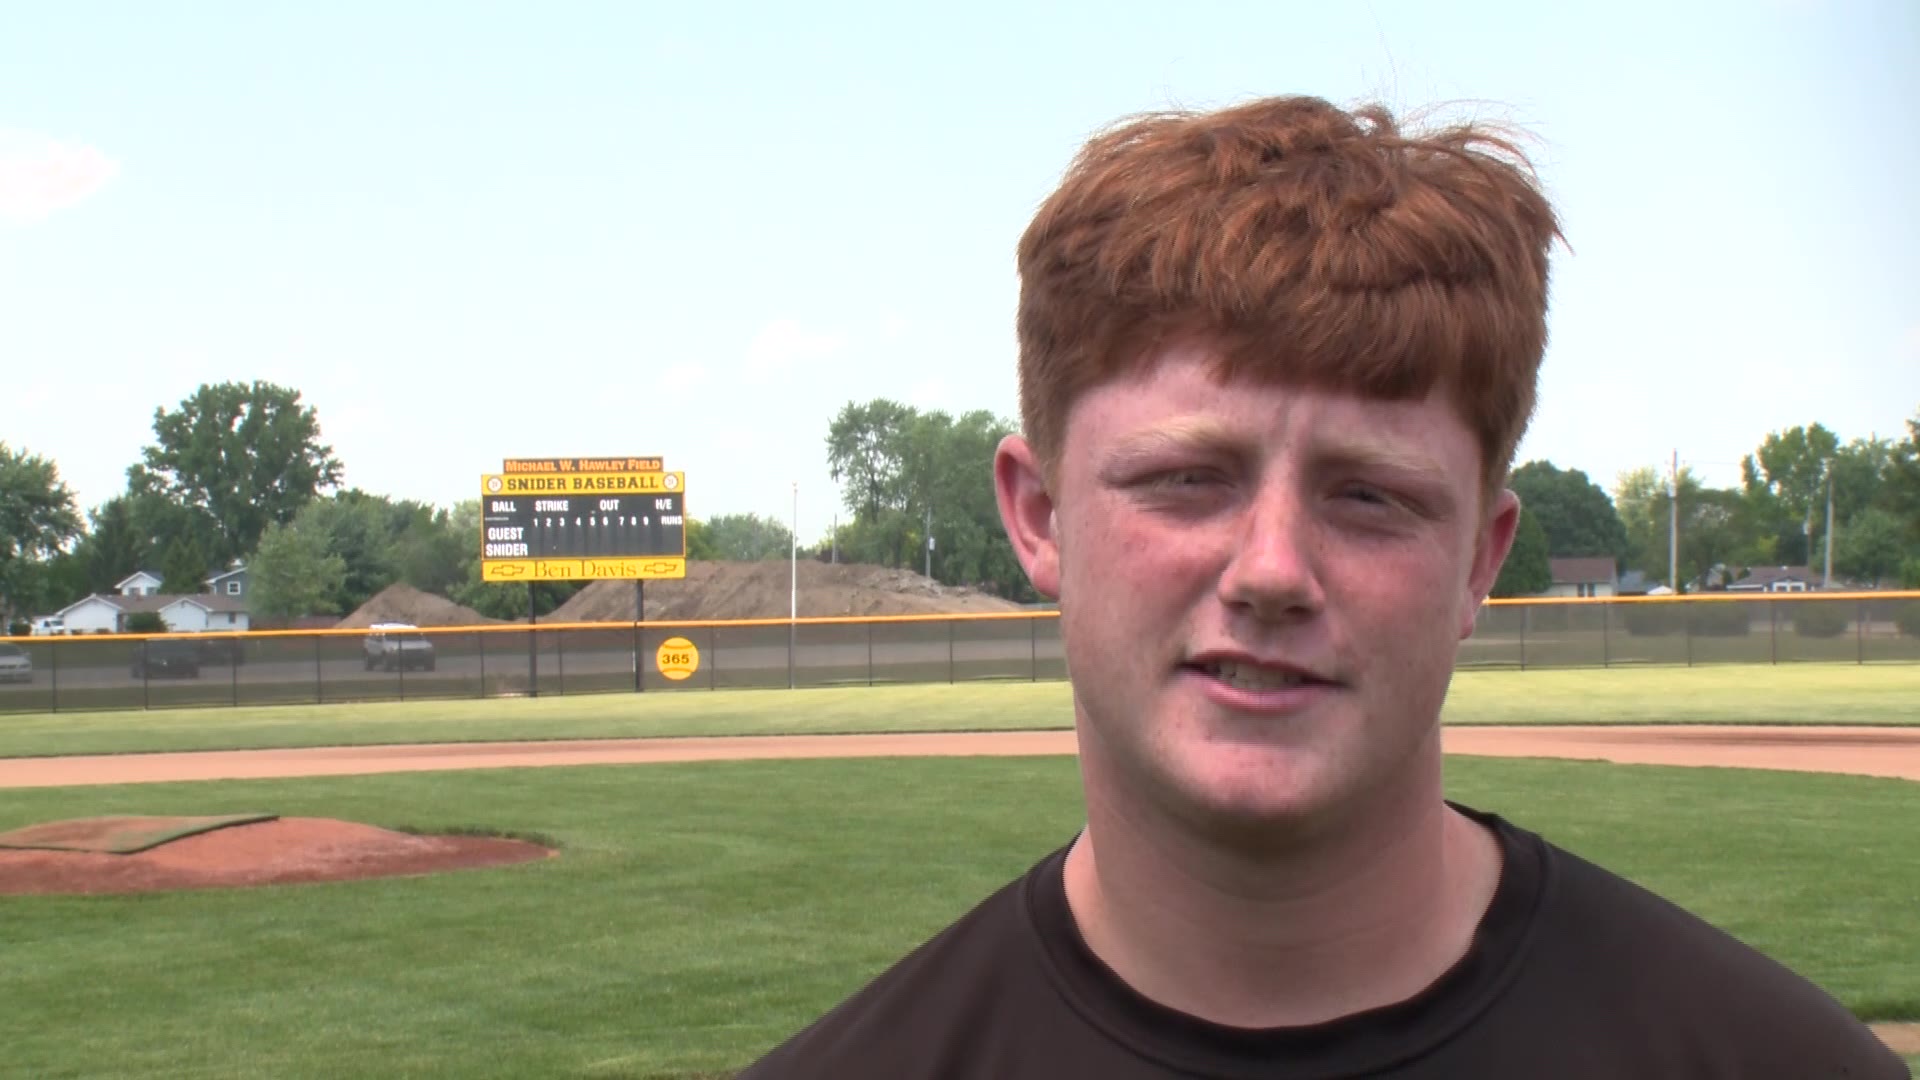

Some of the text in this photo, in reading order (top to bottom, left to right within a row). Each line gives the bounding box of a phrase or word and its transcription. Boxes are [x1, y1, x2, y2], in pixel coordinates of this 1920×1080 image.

[506, 459, 660, 472] MICHAEL W. HAWLEY FIELD
[507, 478, 566, 490] SNIDER
[573, 476, 658, 490] BASEBALL
[492, 501, 516, 512] BALL
[535, 501, 569, 511] STRIKE
[600, 500, 619, 510] OUT
[656, 499, 672, 510] H/E
[534, 518, 538, 527] 1
[546, 518, 551, 527] 2
[560, 518, 565, 527] 3
[576, 517, 581, 526] 4
[619, 516, 624, 526] 7
[661, 516, 682, 525] RUNS
[488, 528, 524, 540] GUEST
[486, 544, 528, 556] SNIDER
[534, 560, 636, 578] Ben Davis
[662, 653, 690, 665] 365
